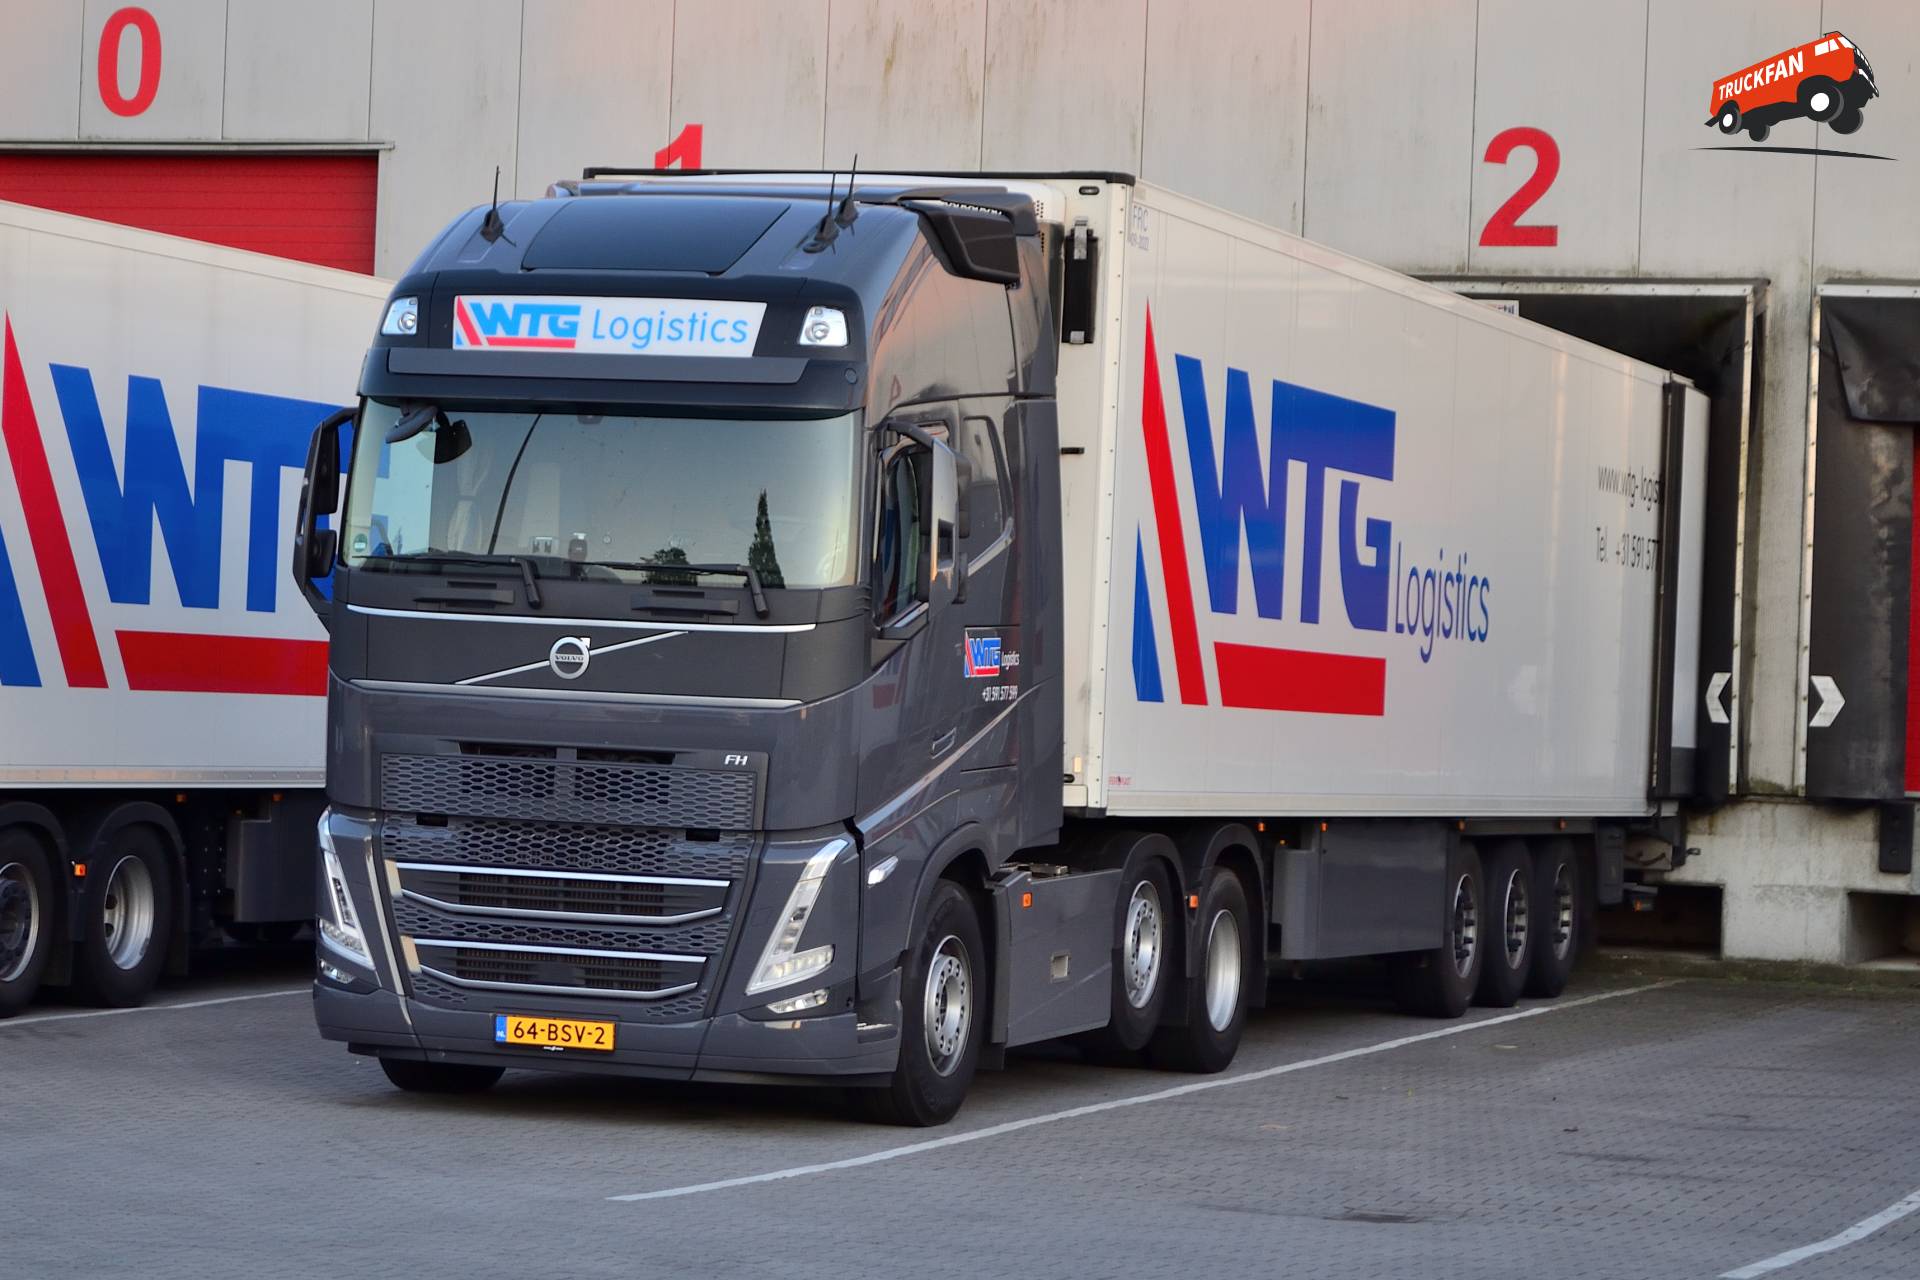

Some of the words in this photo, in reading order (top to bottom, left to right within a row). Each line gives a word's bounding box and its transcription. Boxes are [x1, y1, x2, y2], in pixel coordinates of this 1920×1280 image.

[97, 7, 162, 117] 0
[1479, 127, 1561, 246] 2
[469, 302, 581, 338] WTG
[592, 309, 749, 349] Logistics
[48, 362, 389, 613] WT
[1175, 353, 1396, 632] WTG
[1395, 541, 1490, 663] Logistics
[724, 754, 748, 766] FH
[513, 1021, 605, 1045] 64-BSV-2
